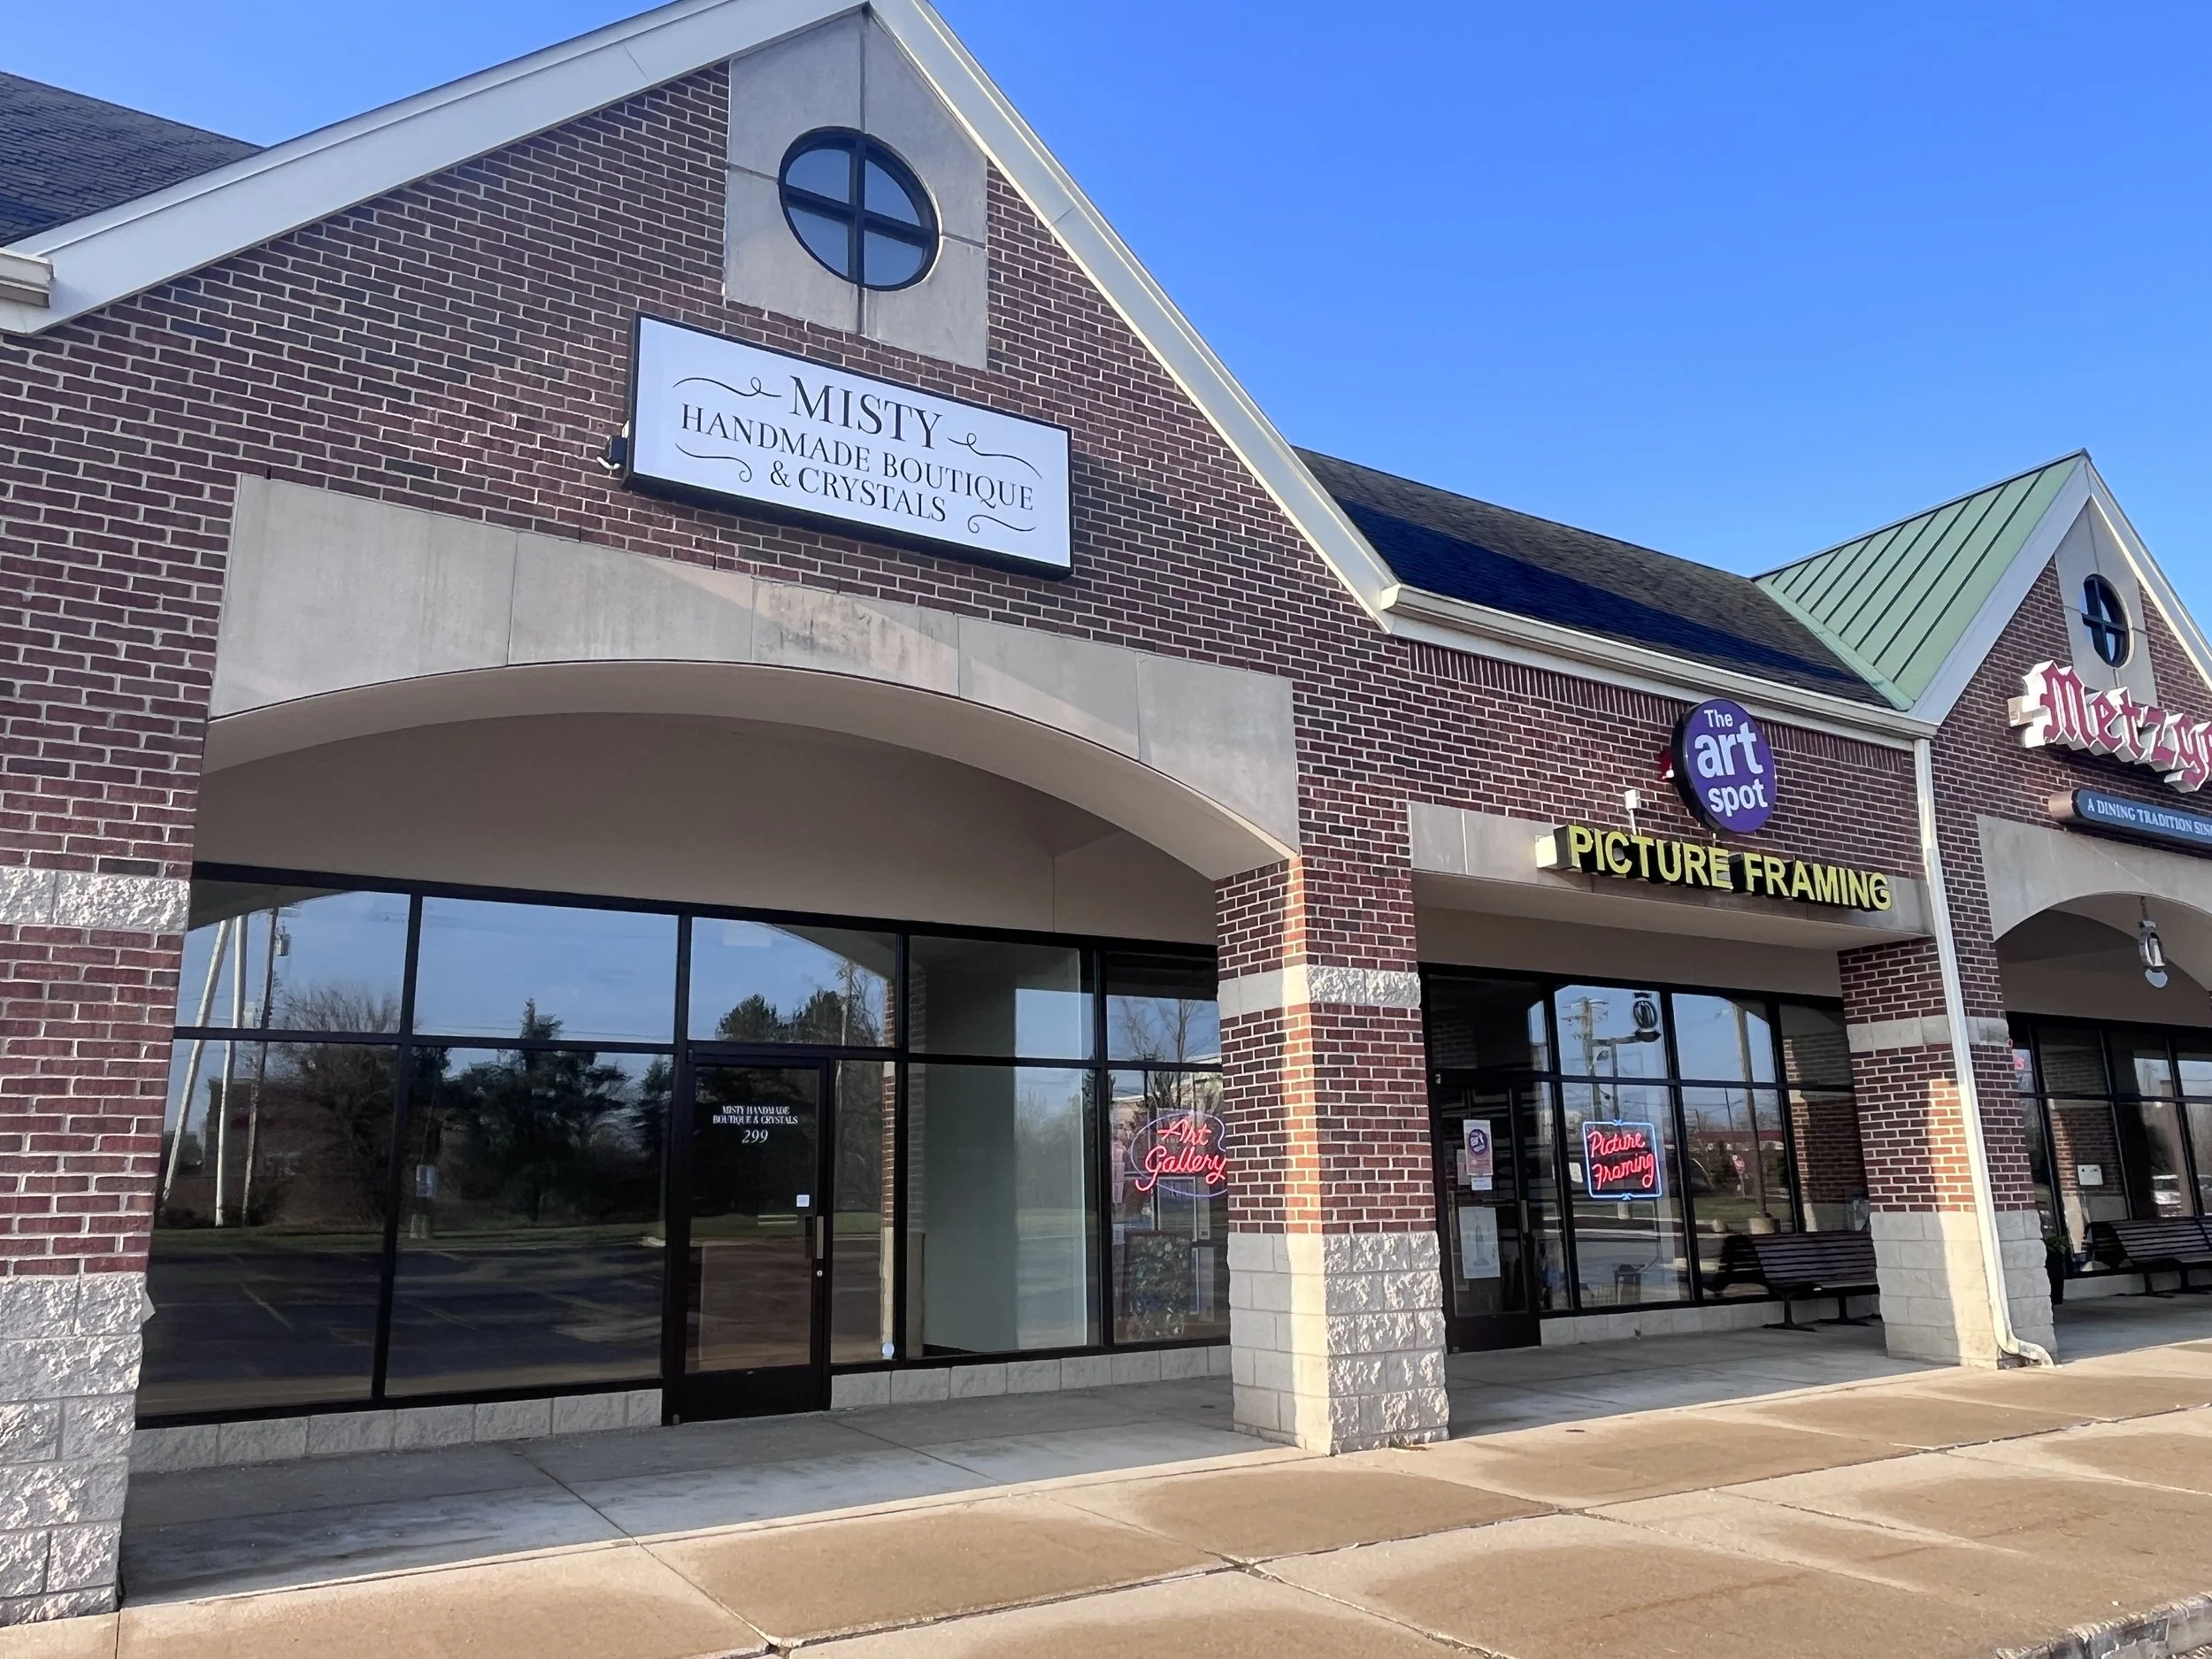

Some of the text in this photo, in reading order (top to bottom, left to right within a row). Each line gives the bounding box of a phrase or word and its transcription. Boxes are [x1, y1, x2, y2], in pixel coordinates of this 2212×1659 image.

[789, 375, 943, 449] MISTY
[681, 403, 1034, 511] HANDMADE BOUTIQUE
[770, 460, 946, 522] & CRYSTALS
[1703, 710, 1733, 727] The
[1694, 721, 1763, 779] art
[1708, 778, 1768, 817] spot
[2087, 798, 2095, 812] A
[2096, 800, 2136, 821] DINING
[2137, 809, 2193, 833] TRADITION
[1569, 825, 1893, 910] PICTURE FRAMING
[712, 1114, 752, 1125] BOUTIQUE
[760, 1116, 798, 1125] CRYSTALS
[722, 1105, 790, 1115] MISTY HANDMADE
[741, 1129, 769, 1143] 299
[1156, 1118, 1212, 1146] Art
[1587, 1130, 1645, 1158] Picture
[1135, 1145, 1230, 1192] Gallery
[1592, 1152, 1655, 1191] Framing
